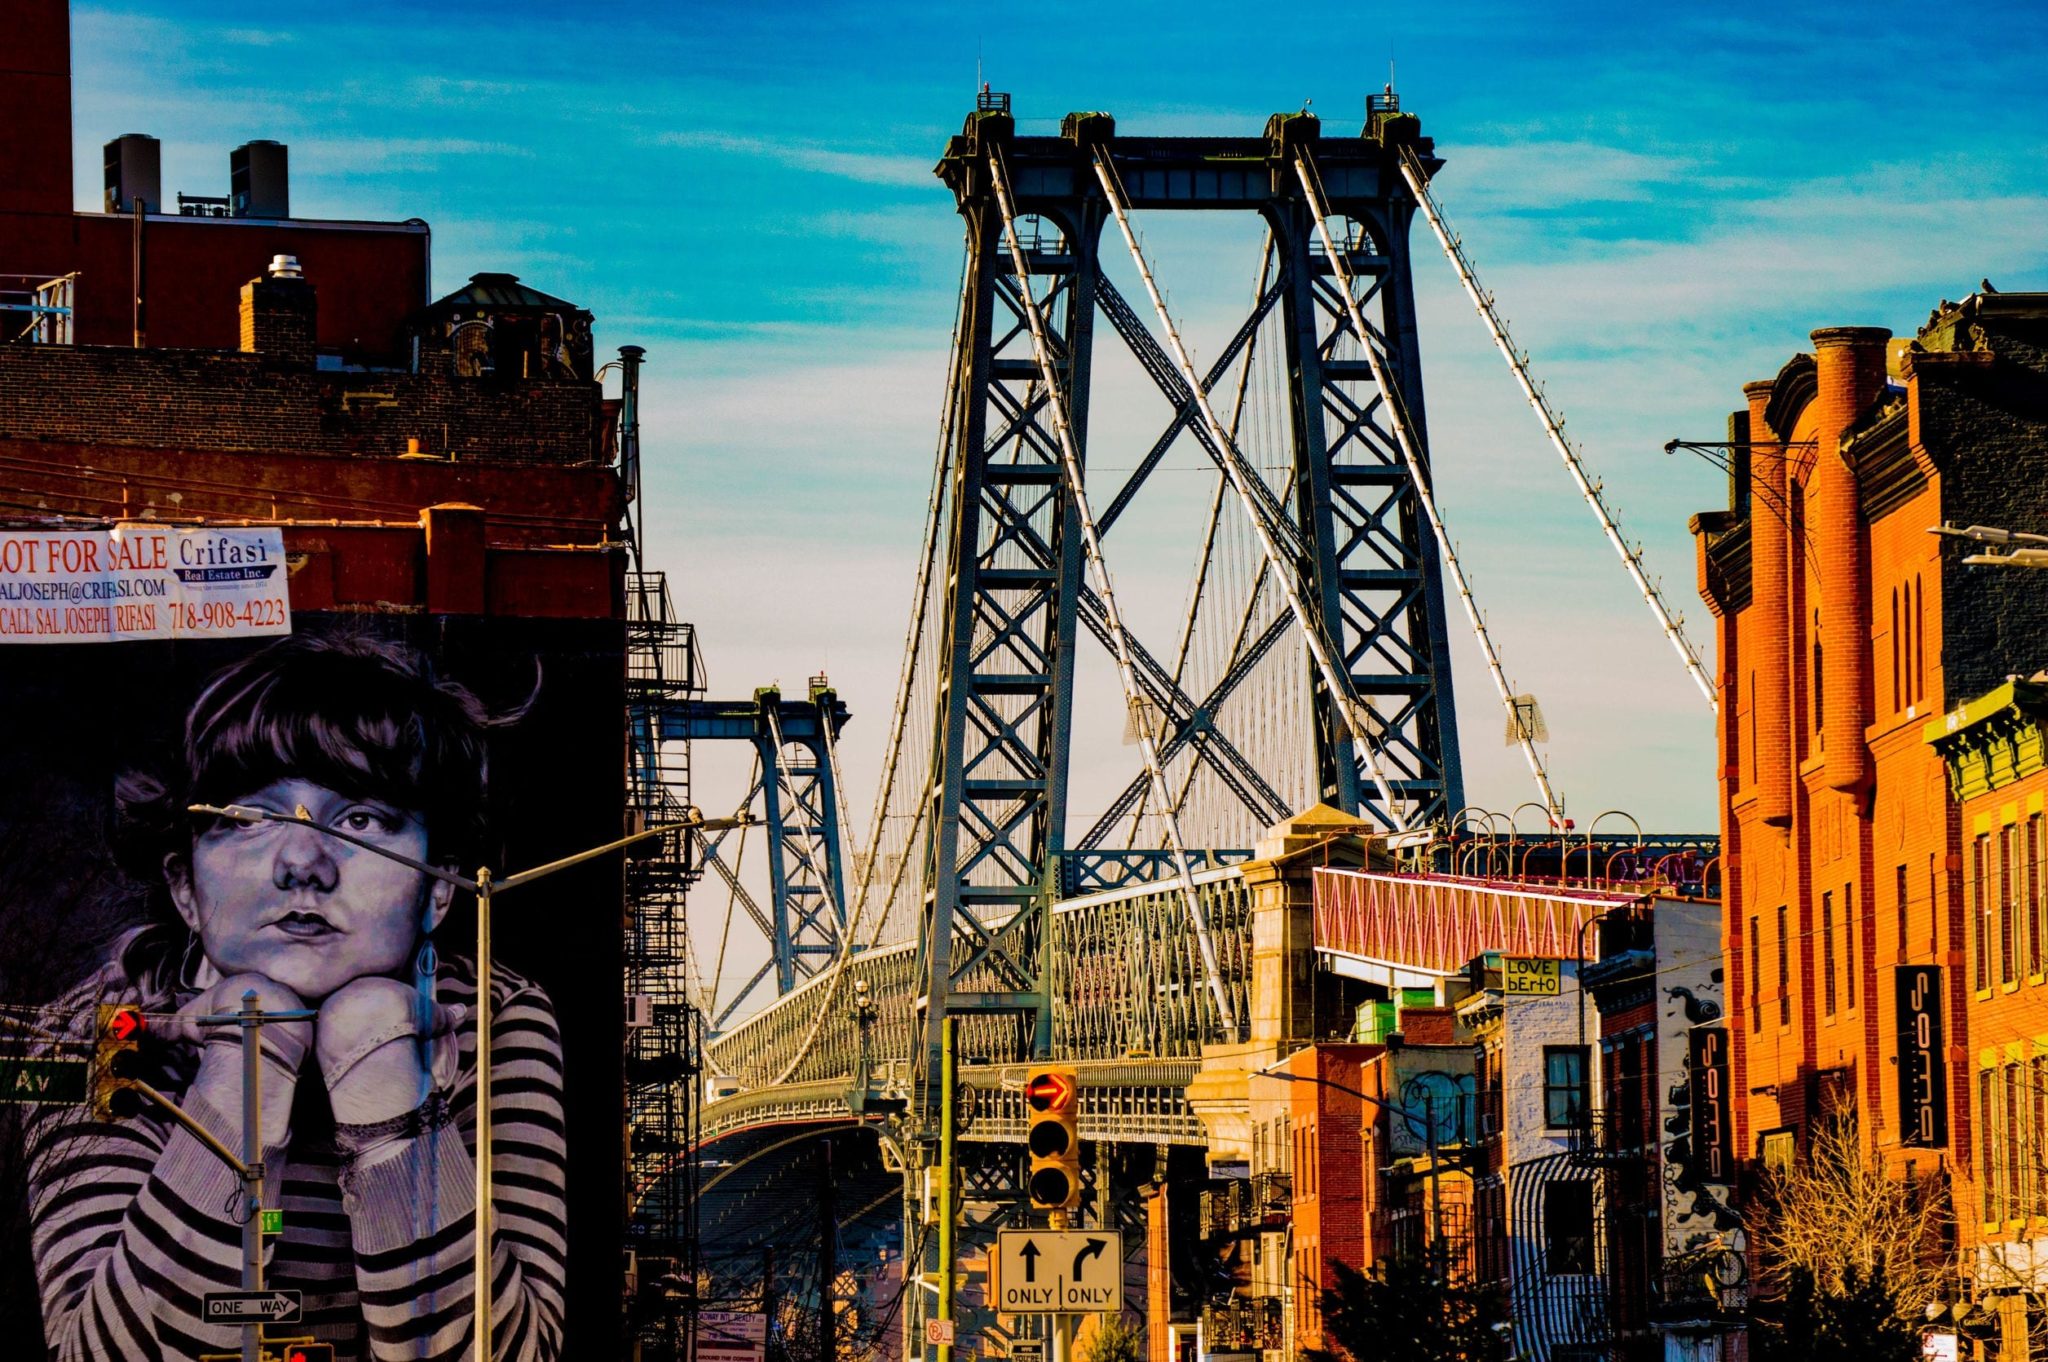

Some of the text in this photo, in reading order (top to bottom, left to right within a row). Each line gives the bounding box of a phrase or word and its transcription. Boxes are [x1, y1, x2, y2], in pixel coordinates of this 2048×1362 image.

[0, 536, 167, 573] OT FOR SALE
[180, 538, 267, 565] Crifasi
[184, 568, 264, 580] Real Estate Inc.
[0, 599, 285, 634] CALL SAL JOSEPH RIFASI 718-908-4223
[1508, 961, 1552, 974] LOVE
[1007, 1288, 1053, 1304] ONLY
[1068, 1288, 1113, 1304] ONLY
[212, 1301, 290, 1313] ONE WAY
[688, 1312, 719, 1321] OADWAY
